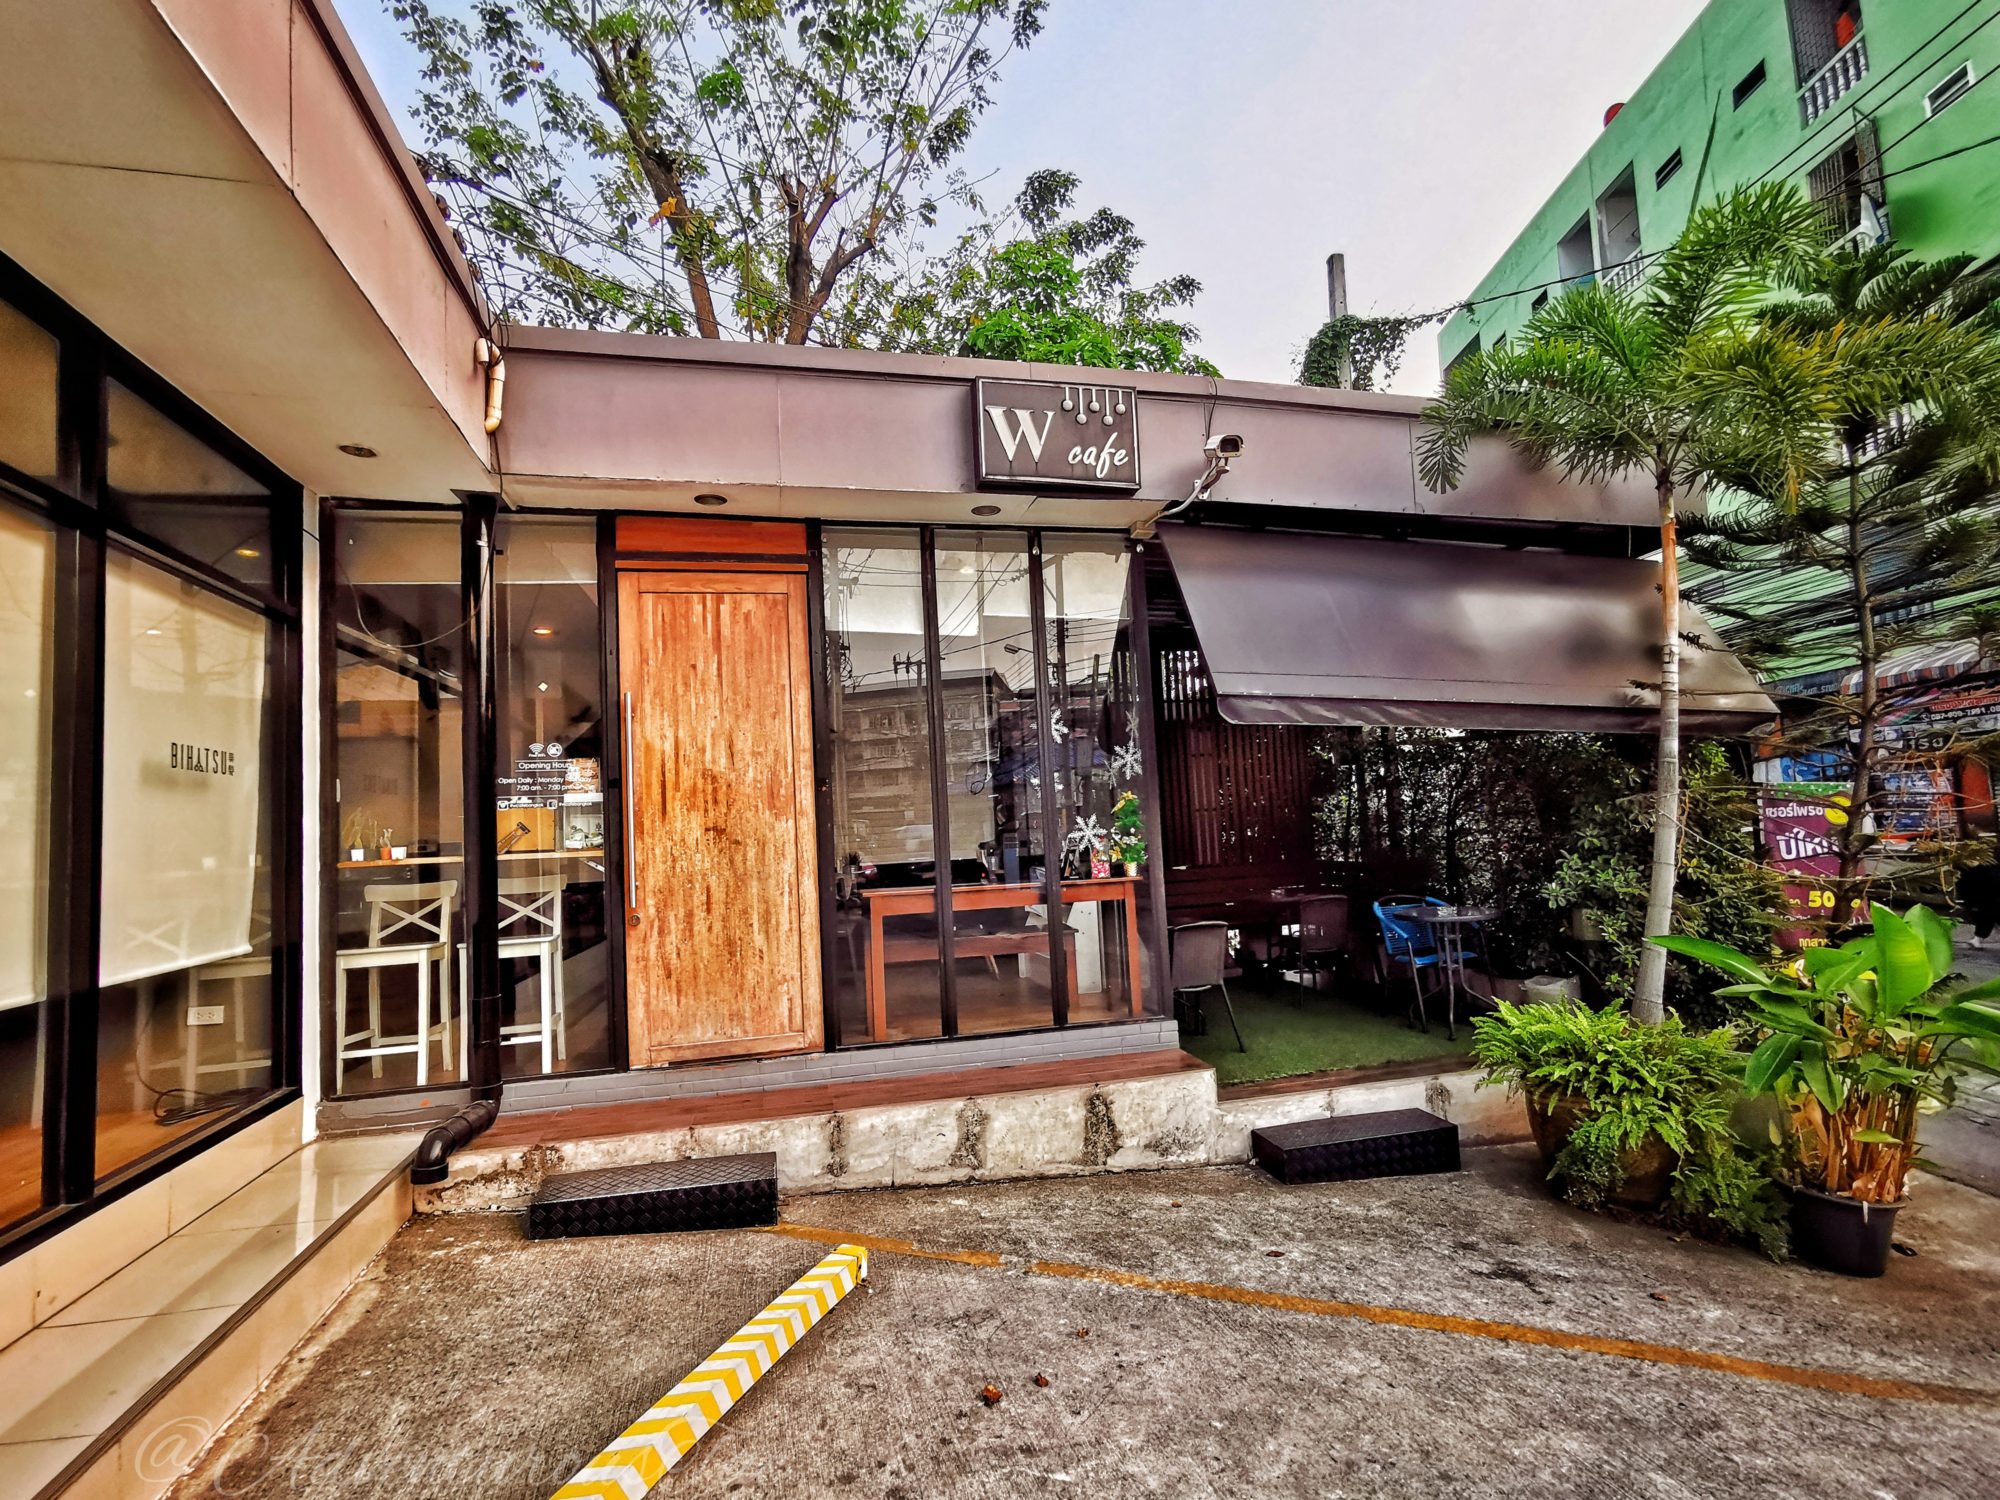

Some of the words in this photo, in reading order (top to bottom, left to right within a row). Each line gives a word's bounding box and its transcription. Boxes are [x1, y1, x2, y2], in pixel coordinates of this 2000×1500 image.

[984, 404, 1056, 463] W
[1067, 431, 1129, 479] cafe
[518, 762, 551, 770] Opening
